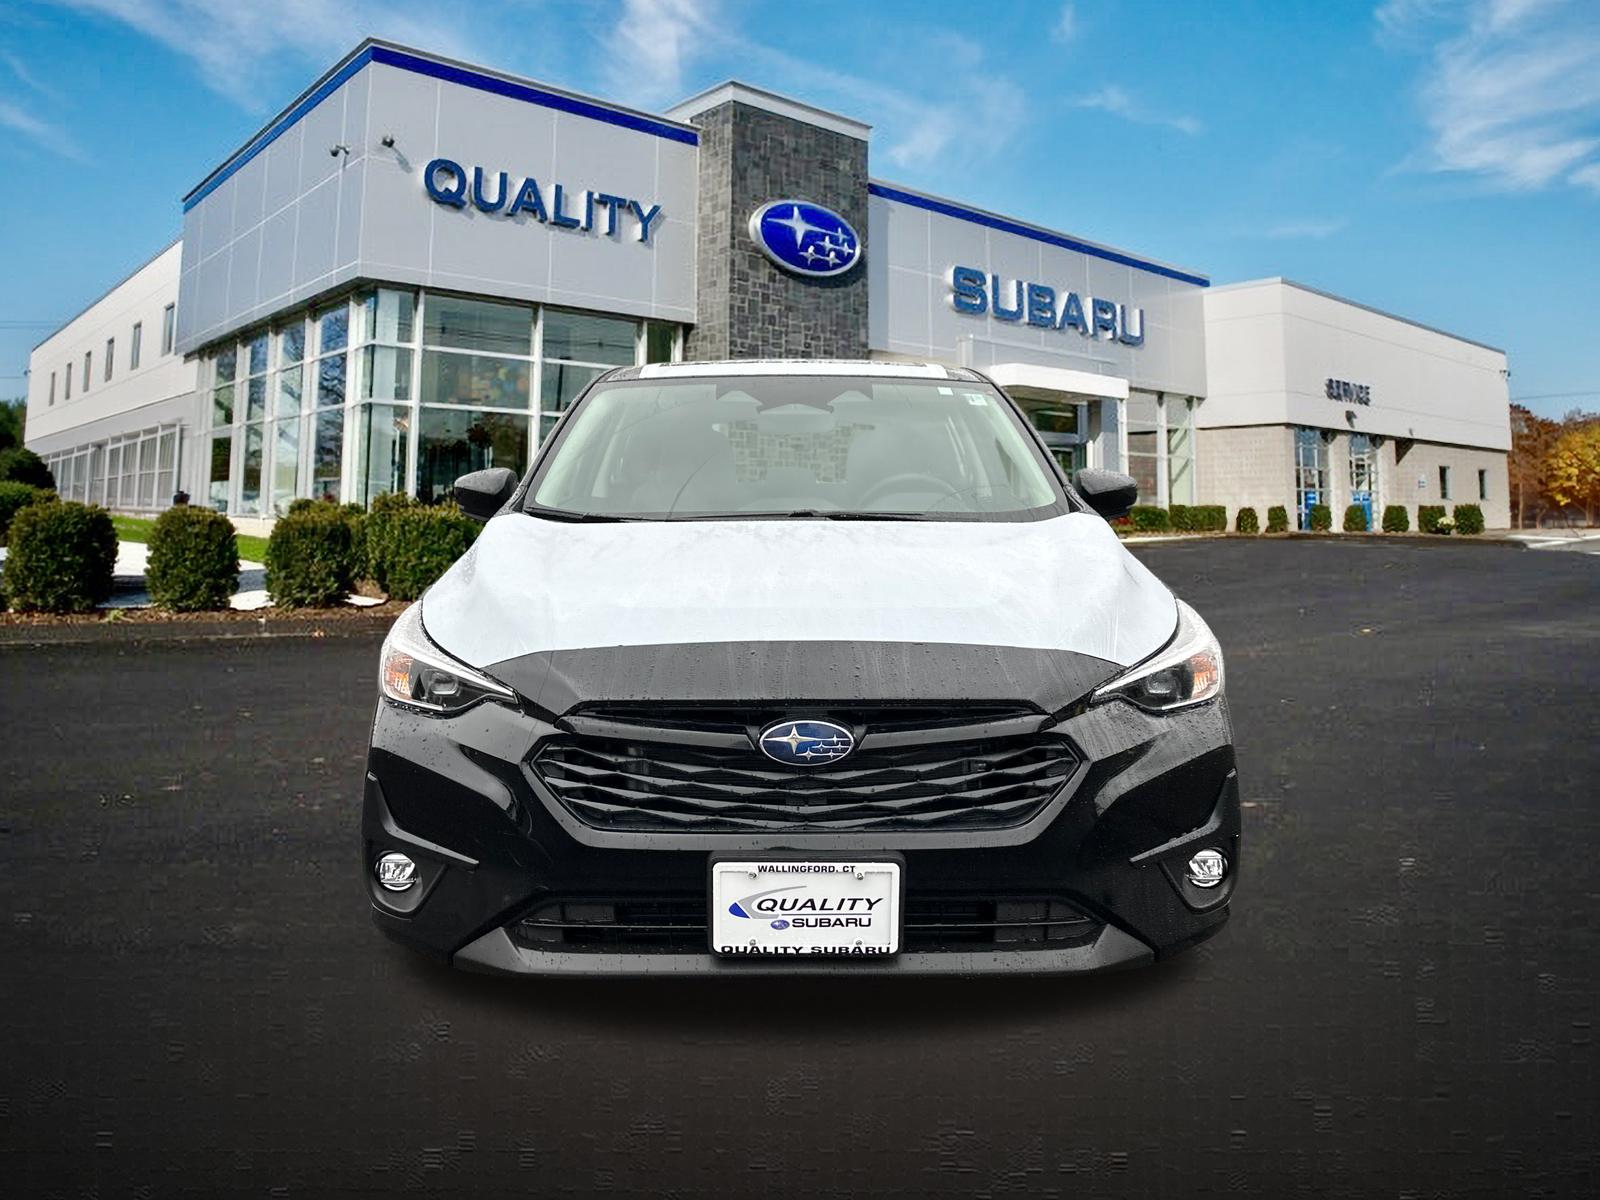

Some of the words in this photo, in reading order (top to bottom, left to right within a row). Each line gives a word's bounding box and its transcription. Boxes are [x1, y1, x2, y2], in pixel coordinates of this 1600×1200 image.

[424, 158, 662, 242] QUALITY
[948, 265, 1145, 346] SUBARU
[842, 865, 856, 873] CT
[756, 898, 884, 912] QUALITY
[792, 918, 872, 928] SUBARU
[720, 945, 804, 955] QUALITY
[810, 945, 891, 955] SUBARU
